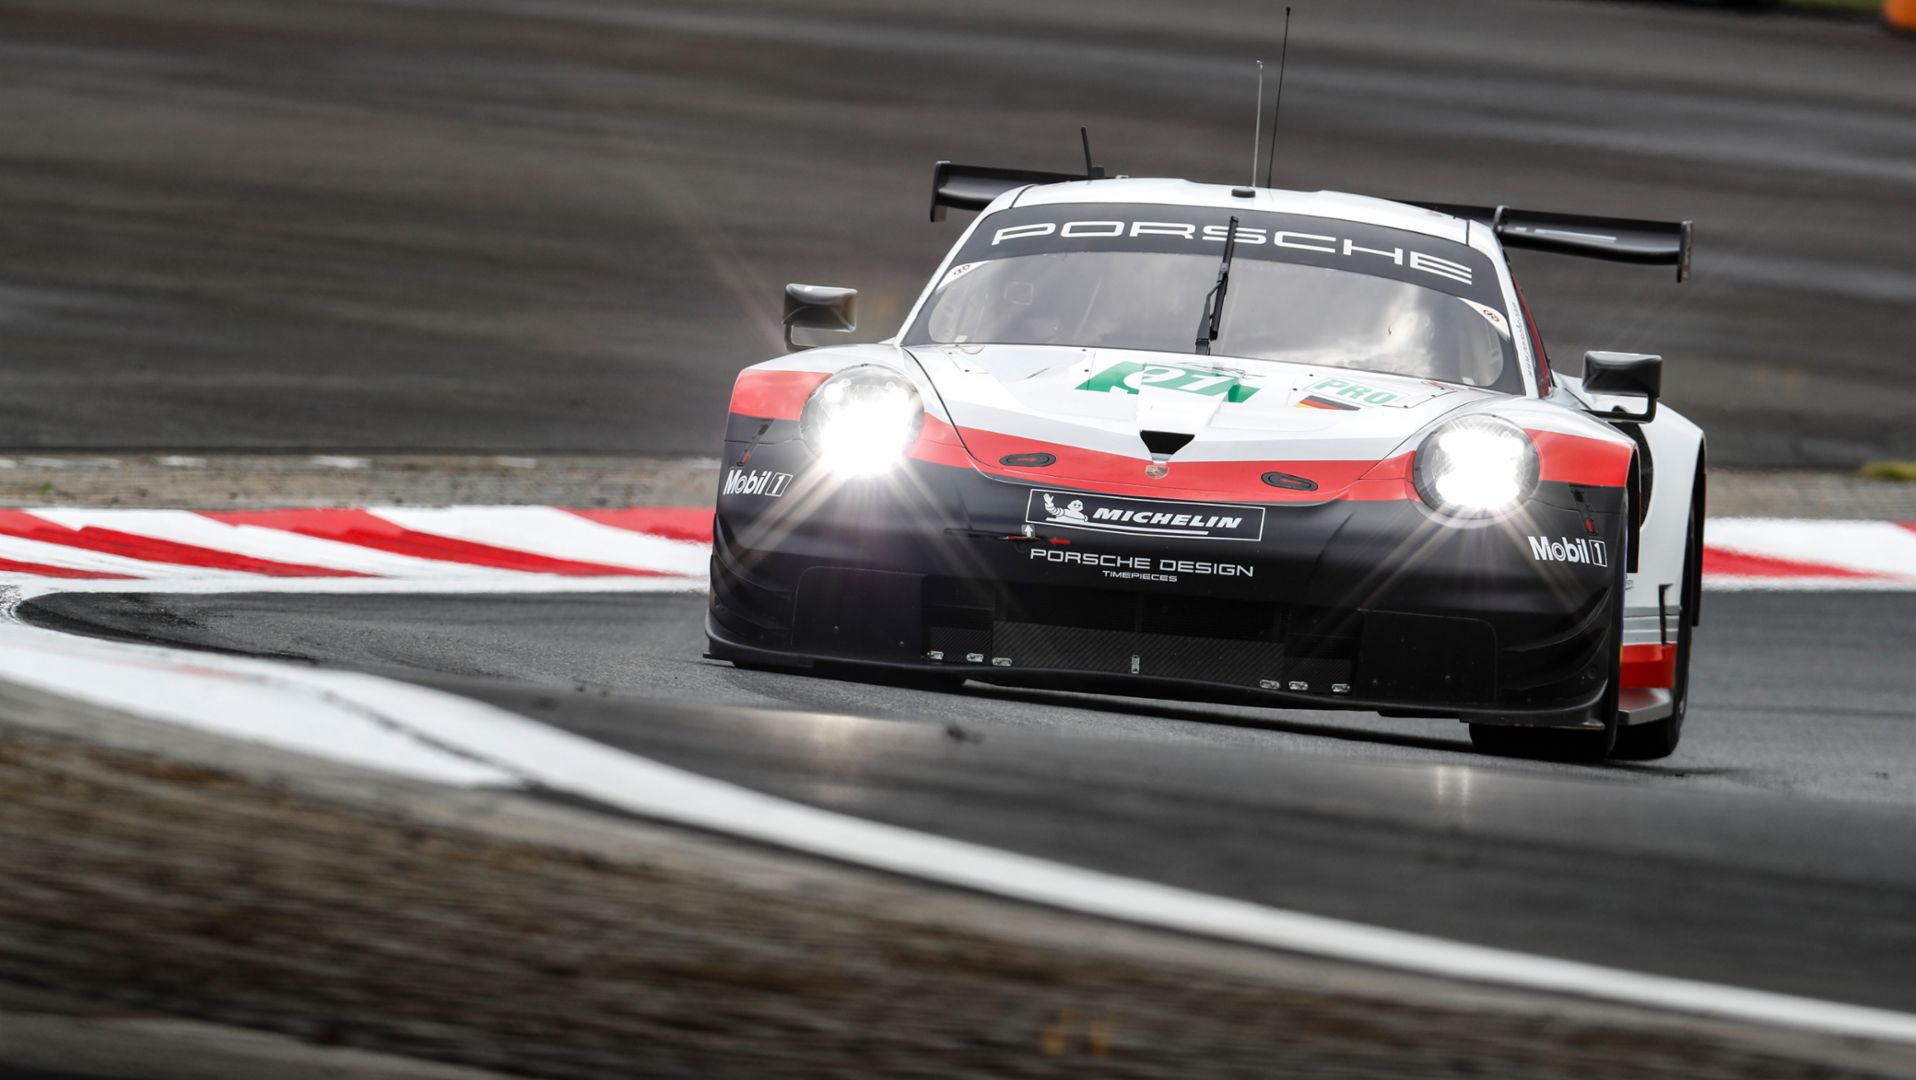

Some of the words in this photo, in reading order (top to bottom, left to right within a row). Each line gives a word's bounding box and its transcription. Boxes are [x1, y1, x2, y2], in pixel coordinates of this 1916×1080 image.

[991, 221, 1473, 286] PORSCHE
[1313, 379, 1399, 404] PRO
[723, 469, 773, 495] Mobil
[1092, 507, 1242, 529] MICHELIN
[1030, 548, 1151, 570] PORSCHE
[1159, 559, 1254, 578] DESIGN
[1528, 536, 1590, 564] Mobil
[1102, 570, 1178, 582] TIMEPIECES
